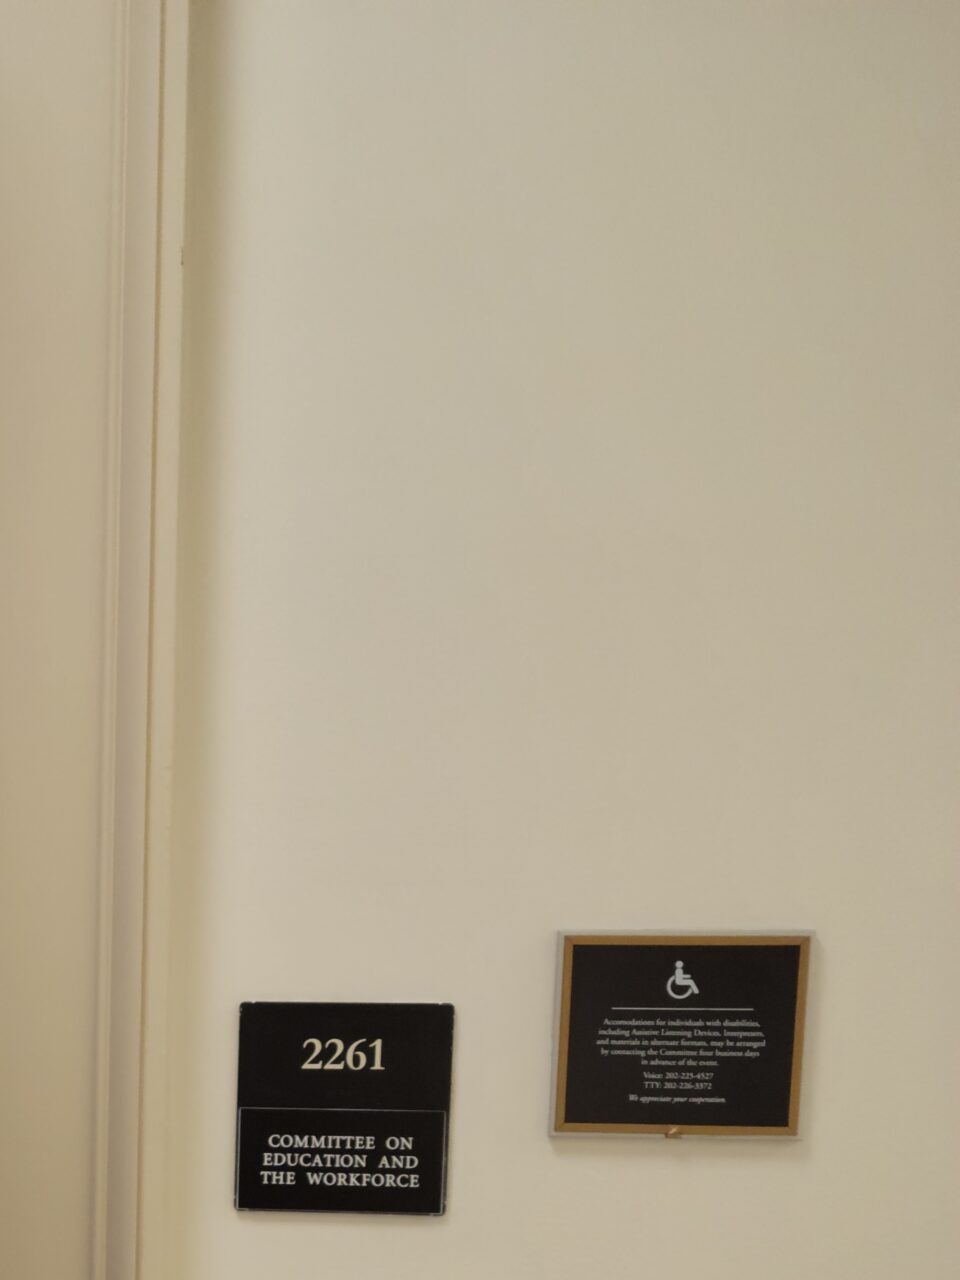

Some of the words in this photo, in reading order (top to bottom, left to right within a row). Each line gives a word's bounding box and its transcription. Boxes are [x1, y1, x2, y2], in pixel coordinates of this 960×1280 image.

[596, 1037, 610, 1046] and
[710, 1041, 725, 1049] may
[726, 1039, 735, 1048] be
[735, 1039, 767, 1050] arranged
[301, 1037, 386, 1070] 2261
[600, 1047, 610, 1057] by
[647, 1047, 659, 1056] the
[744, 1048, 761, 1059] days
[686, 1058, 698, 1066] the
[267, 1134, 376, 1150] COMMITTEE
[385, 1136, 414, 1150] ON
[262, 1152, 368, 1168] EDUCATION
[378, 1155, 419, 1169] AND
[260, 1171, 296, 1185] THE
[306, 1172, 420, 1188] WORKFORCE
